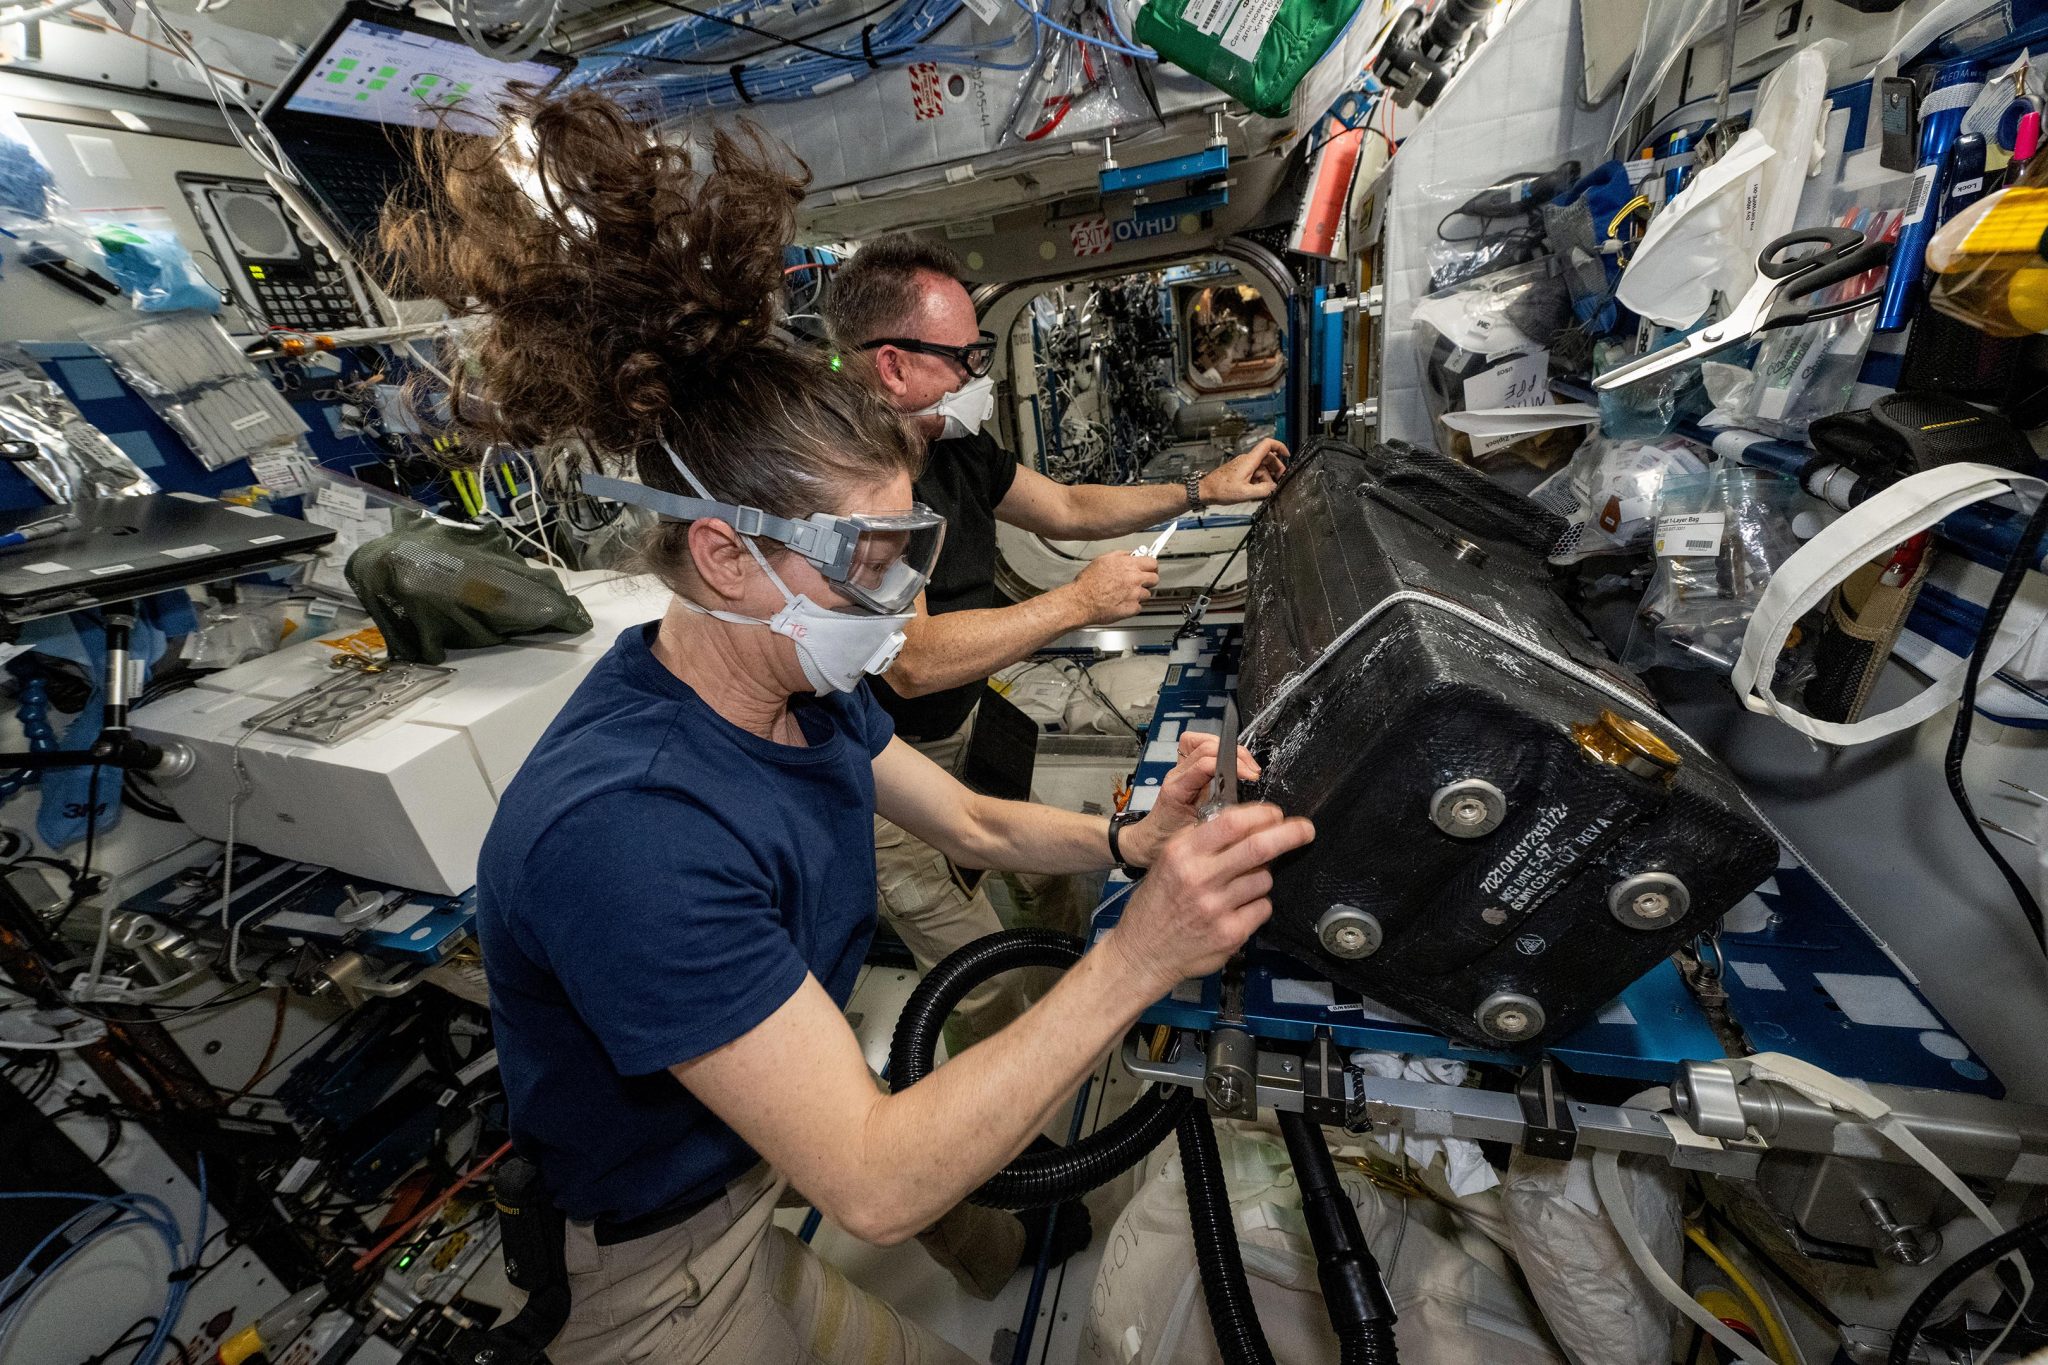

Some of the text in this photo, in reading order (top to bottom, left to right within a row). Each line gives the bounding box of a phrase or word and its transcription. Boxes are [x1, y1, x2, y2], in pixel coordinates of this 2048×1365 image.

[1230, 3, 1256, 47] Салфетки
[1241, 24, 1252, 42] для
[1957, 182, 1978, 193] Lock
[1076, 227, 1105, 248] EXIT
[1115, 216, 1177, 240] OVHD
[1476, 319, 1491, 330] 3M
[1504, 373, 1537, 400] PPE
[1484, 434, 1510, 449] Ziplock
[1575, 824, 1602, 846] REV
[1595, 817, 1613, 828] A
[1498, 885, 1520, 903] MFG
[1513, 866, 1537, 888] DATE
[1527, 841, 1555, 870] 5-97
